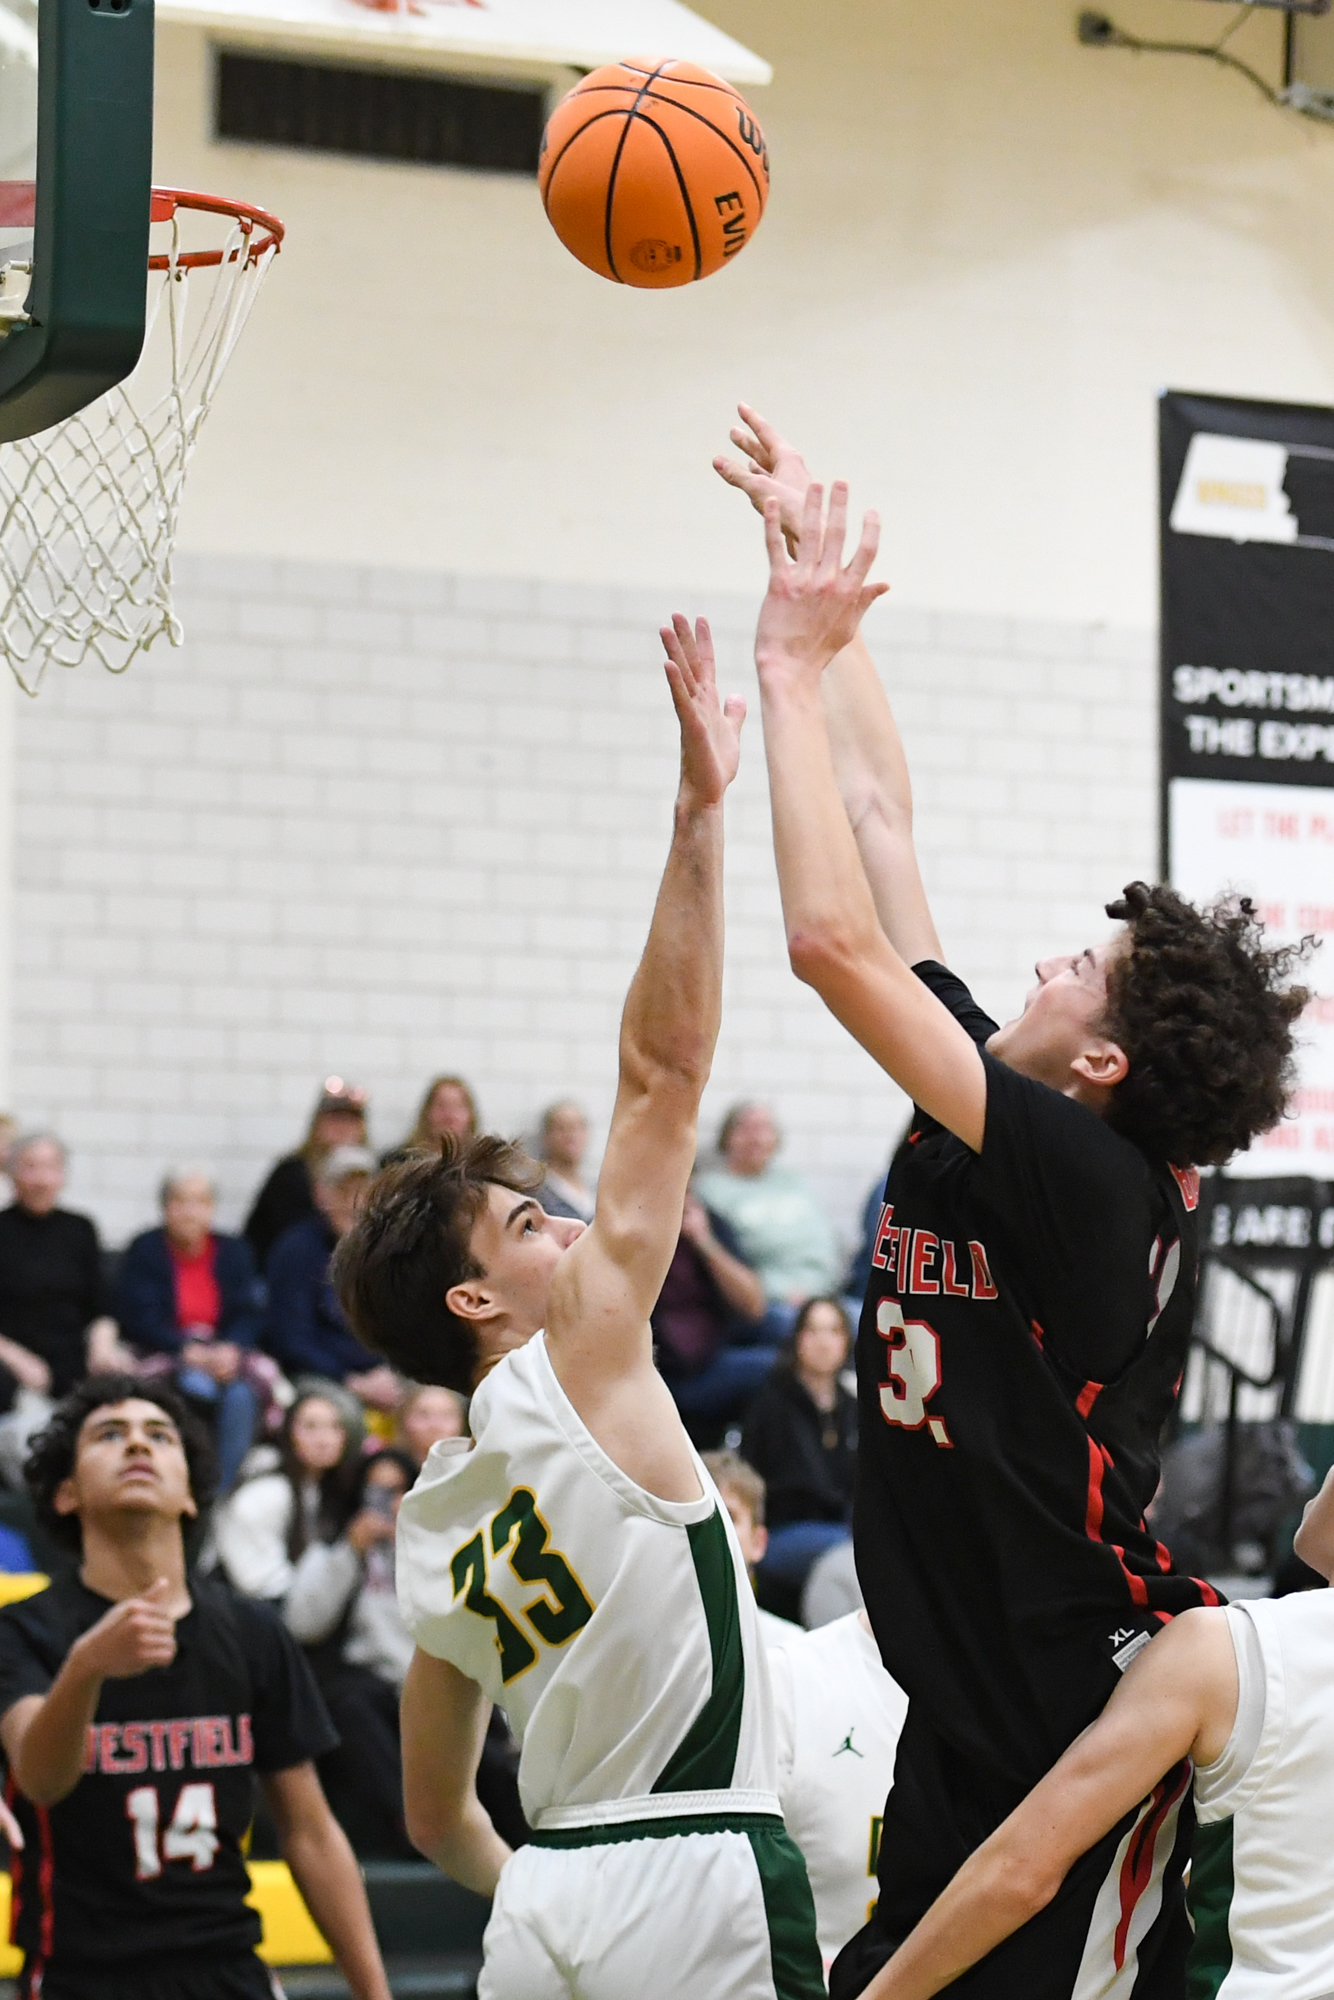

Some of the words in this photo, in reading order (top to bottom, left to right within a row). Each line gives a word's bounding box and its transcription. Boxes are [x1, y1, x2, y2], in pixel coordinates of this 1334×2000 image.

[1184, 714, 1255, 757] THE
[449, 1484, 597, 1688] 33
[1108, 1628, 1135, 1648] XL
[126, 1782, 220, 1881] 14
